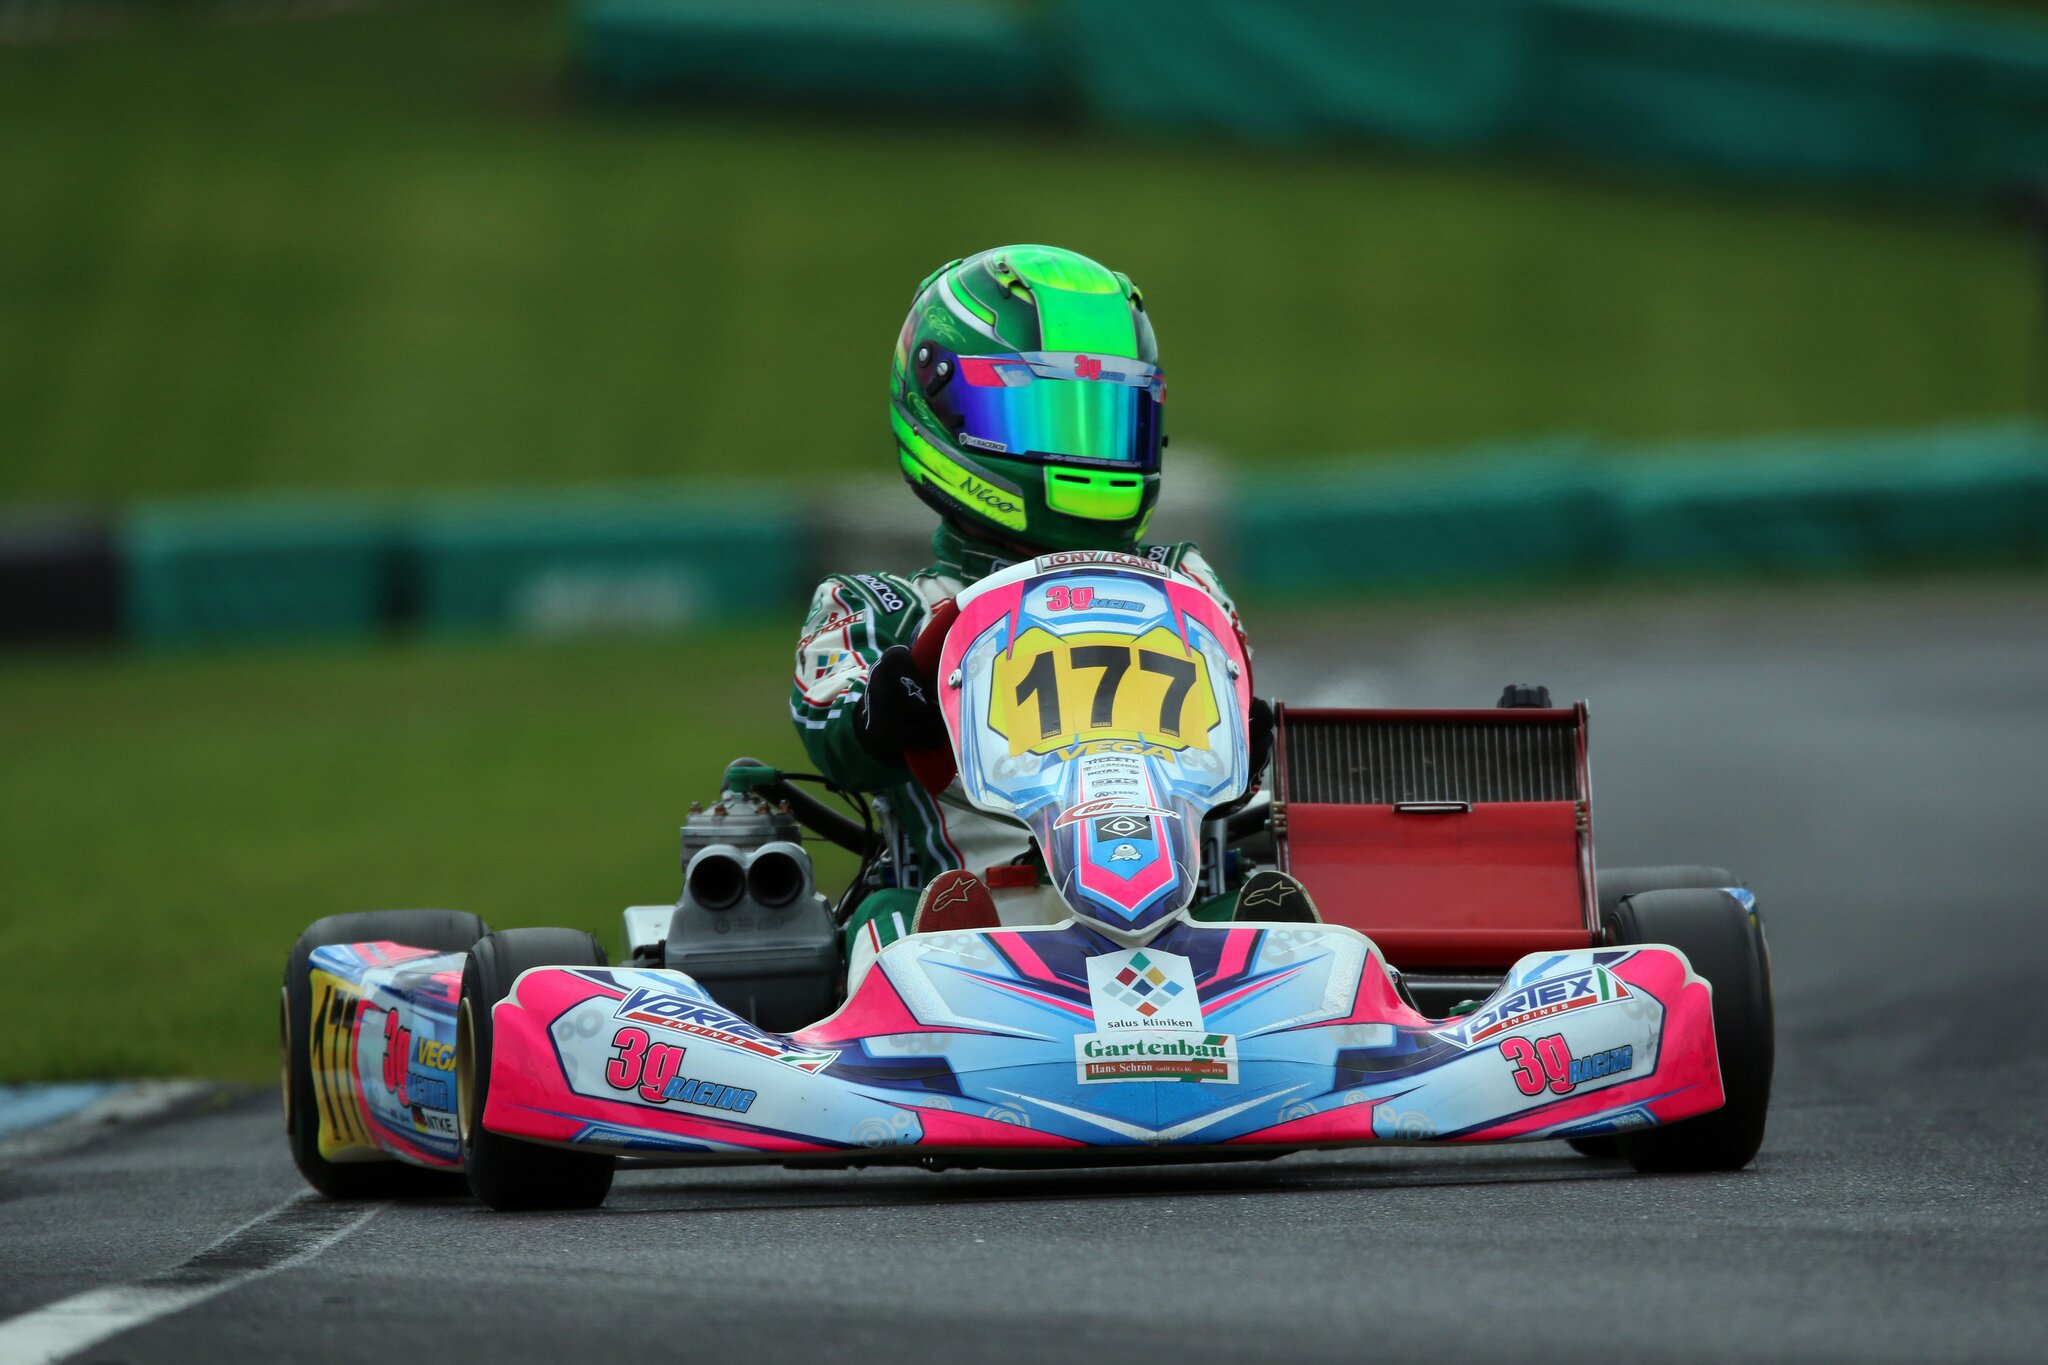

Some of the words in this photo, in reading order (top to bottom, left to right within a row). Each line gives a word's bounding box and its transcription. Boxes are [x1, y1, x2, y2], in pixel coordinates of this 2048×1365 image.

[960, 477, 1022, 513] Nico
[1046, 586, 1094, 611] 3g
[1015, 645, 1197, 739] 177
[1056, 741, 1176, 764] VEGA
[1433, 969, 1595, 1046] VORTEX
[1501, 1003, 1569, 1029] ENGINES
[662, 1020, 746, 1046] ENGINES
[1107, 1019, 1139, 1029] salus
[1143, 1018, 1193, 1028] kliniken
[1084, 1039, 1226, 1058] Gartenbau
[606, 1026, 686, 1104] 3g
[662, 1076, 757, 1113] RACING
[1091, 1064, 1116, 1074] Hans
[1119, 1062, 1153, 1073] Schrön
[1500, 1032, 1577, 1096] 3g
[1569, 1045, 1634, 1085] RACING
